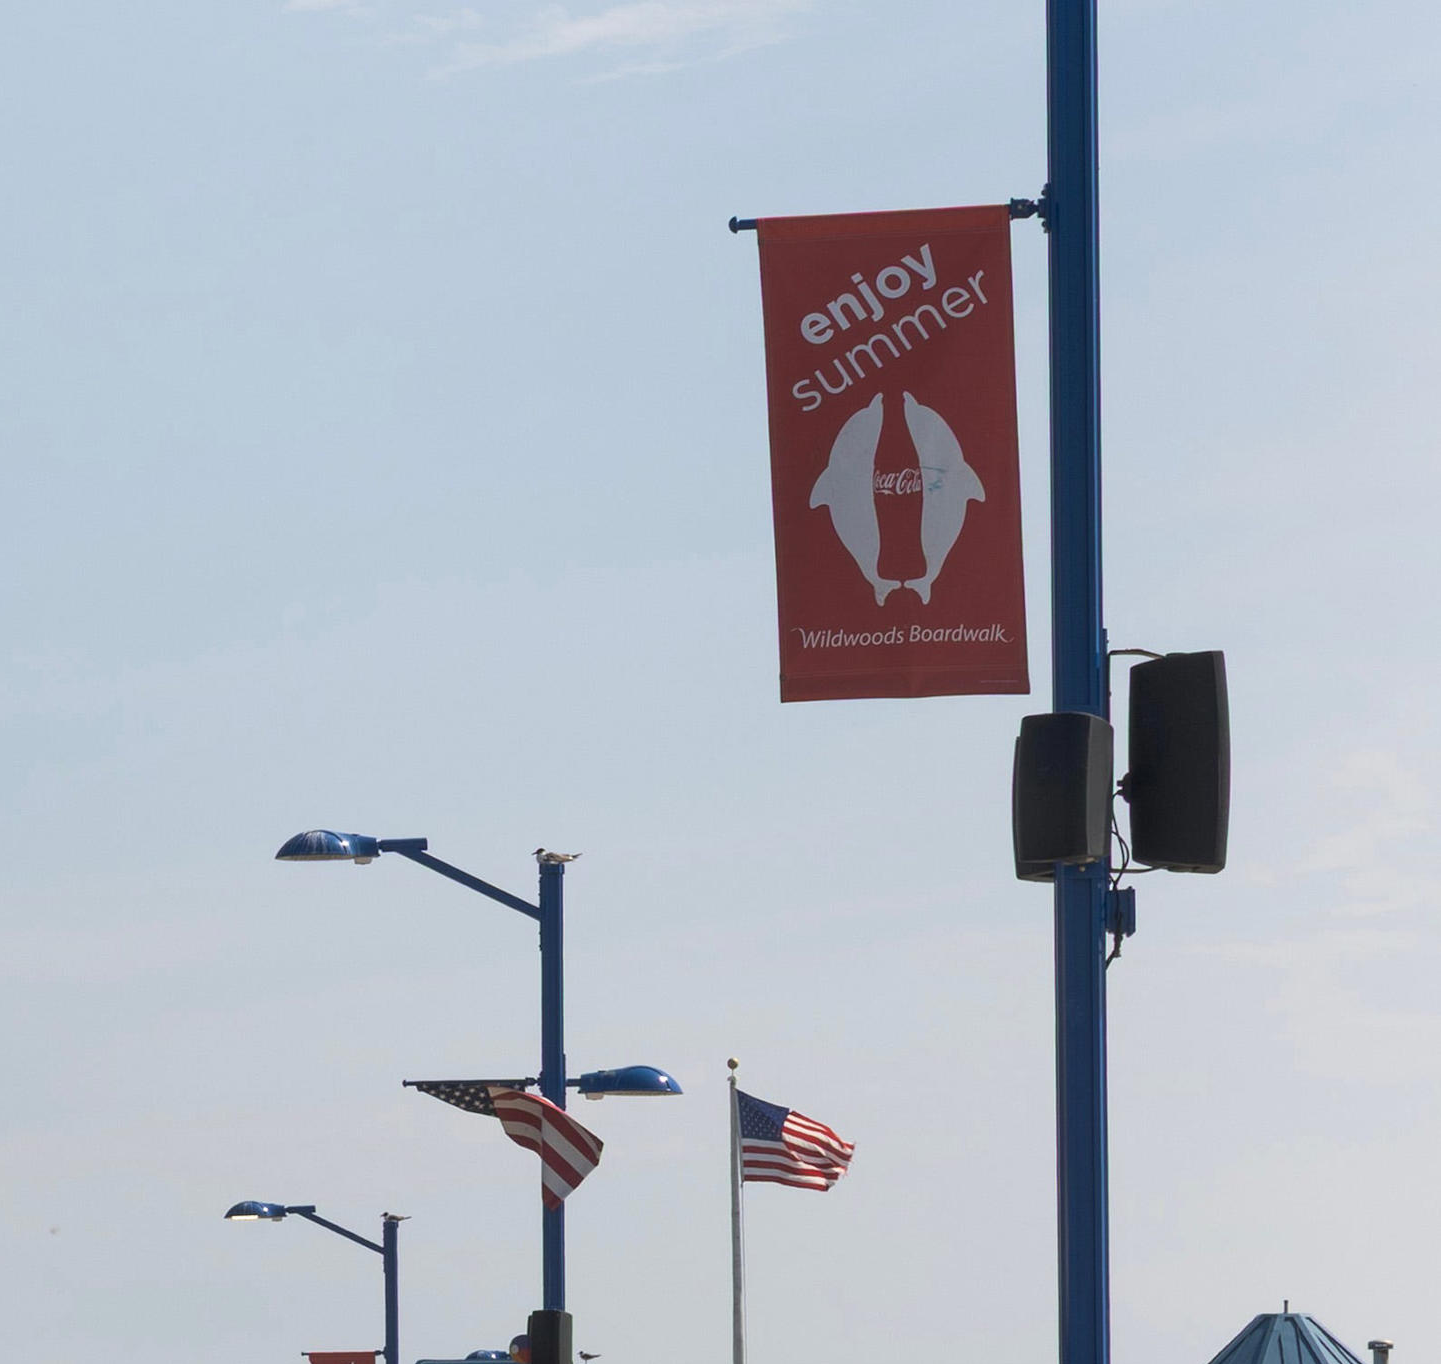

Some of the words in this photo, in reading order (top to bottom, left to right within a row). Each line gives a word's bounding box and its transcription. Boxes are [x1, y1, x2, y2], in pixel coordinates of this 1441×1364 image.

[790, 268, 989, 412] summer
[799, 242, 938, 345] enjoy
[791, 627, 905, 649] Wildwoods
[908, 623, 1015, 646] Boardwalk
